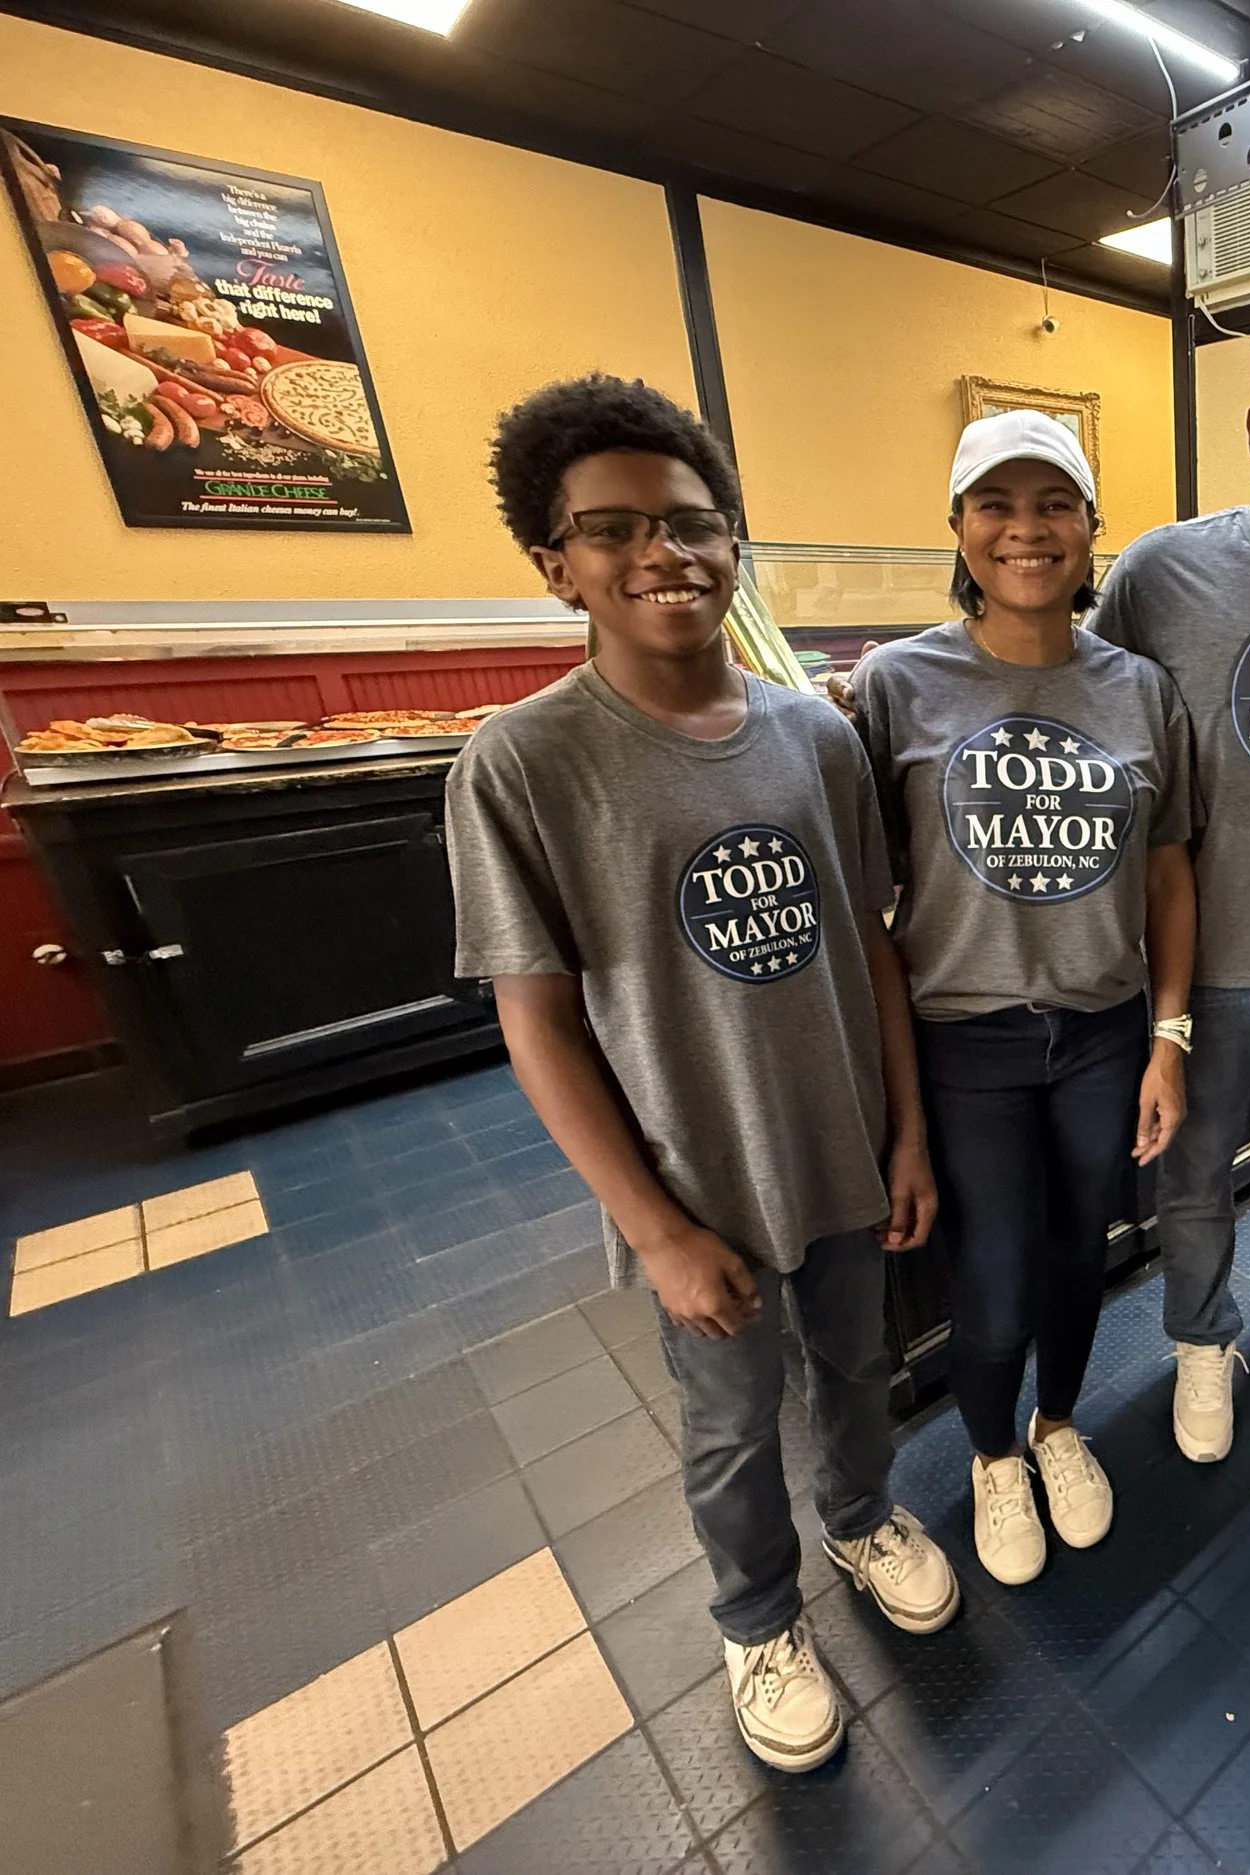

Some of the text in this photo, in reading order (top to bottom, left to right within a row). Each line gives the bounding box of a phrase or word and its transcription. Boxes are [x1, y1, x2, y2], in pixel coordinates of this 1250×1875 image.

[221, 193, 278, 212] big difference
[263, 211, 277, 221] the
[236, 259, 305, 291] Taste
[214, 278, 334, 310] that difference
[239, 298, 322, 324] right here!
[181, 501, 200, 512] The
[200, 502, 226, 513] finest
[228, 503, 259, 513] Italian
[293, 507, 322, 517] money
[322, 508, 338, 516] can
[962, 749, 1116, 793] TODD
[1025, 794, 1062, 811] FOR
[965, 814, 1117, 850] MAYOR
[986, 854, 1100, 870] OF ZEBULON, NC
[692, 855, 805, 905] TODD
[750, 894, 778, 911] FOR
[705, 902, 817, 951] MAYOR
[729, 932, 813, 963] OF ZEBULON, NC
